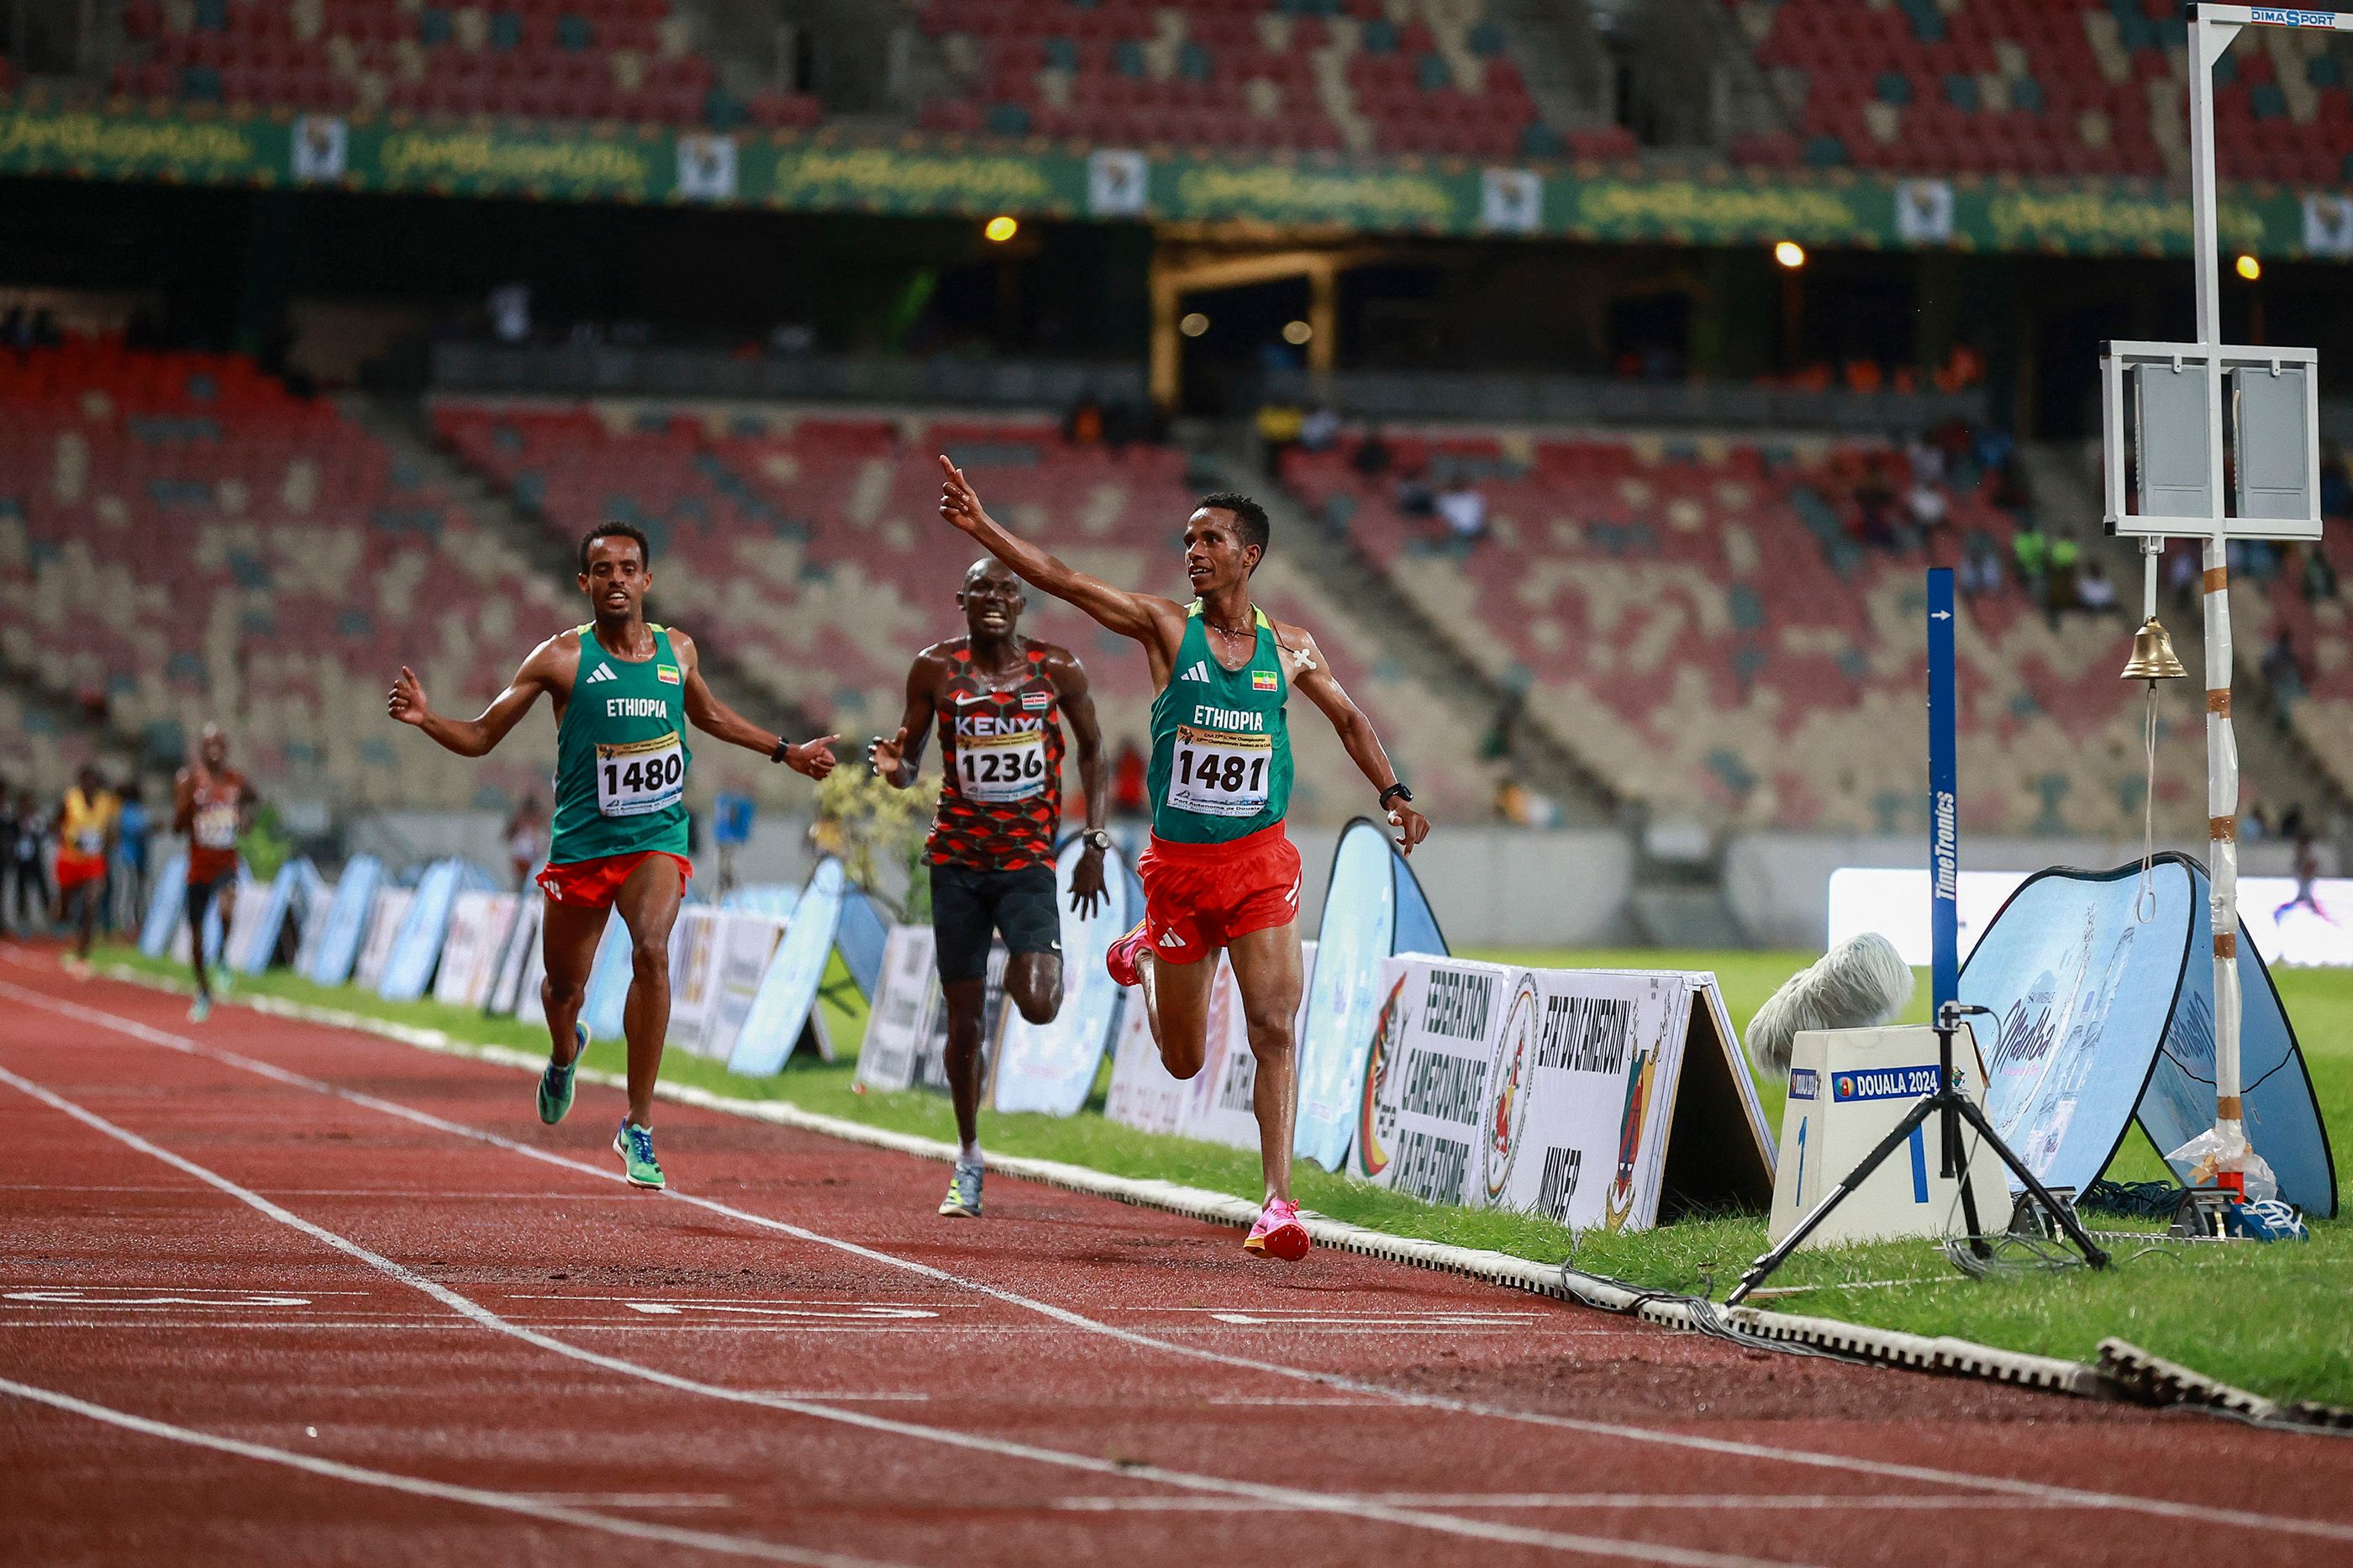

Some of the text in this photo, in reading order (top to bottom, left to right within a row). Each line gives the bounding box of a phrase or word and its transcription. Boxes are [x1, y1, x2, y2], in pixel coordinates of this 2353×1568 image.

[606, 698, 667, 718] ETHIOPIA
[955, 716, 1043, 737] KENYA
[1193, 704, 1263, 731] ETHIOPIA
[604, 753, 682, 795] 1480
[962, 749, 1043, 782] 1236
[1179, 750, 1265, 792] 1481
[1188, 801, 1225, 810] Autonome
[1935, 791, 1956, 902] TimeTronics
[1422, 970, 1492, 1042] FEDERATION
[1575, 997, 1630, 1075] CAMEROUN
[1997, 998, 2056, 1074] Madiba
[1402, 1048, 1487, 1127] CAMEROUNAISE
[1856, 1071, 1939, 1097] DOUALA 2024
[1798, 1116, 1808, 1207] 1
[1537, 1146, 1582, 1223] MINSEP
